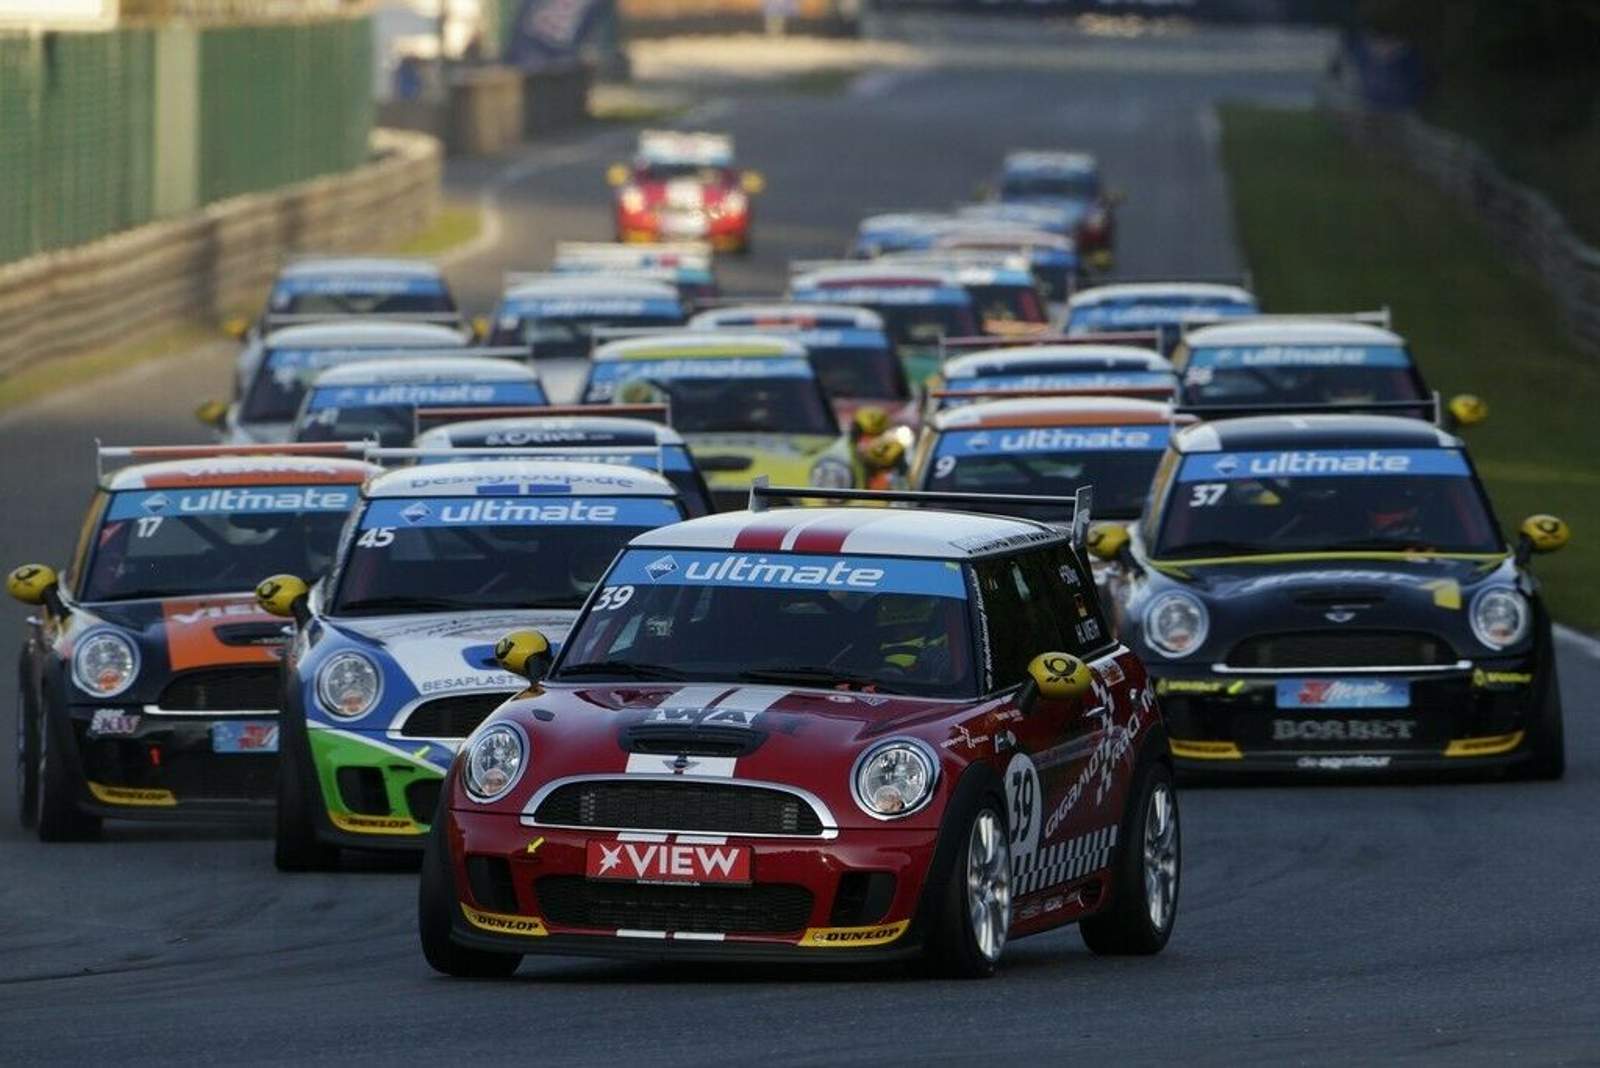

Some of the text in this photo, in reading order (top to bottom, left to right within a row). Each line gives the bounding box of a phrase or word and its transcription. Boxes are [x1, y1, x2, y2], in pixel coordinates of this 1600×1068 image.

[1000, 428, 1151, 450] ultimate
[934, 456, 956, 478] 9
[1251, 452, 1411, 474] ultimate
[180, 488, 349, 511] ultimate
[1189, 484, 1227, 507] 37
[439, 501, 619, 523] ultimate
[136, 517, 163, 538] 17
[357, 527, 398, 549] 45
[684, 555, 884, 588] ultimate
[591, 585, 635, 612] 39
[422, 675, 516, 692] BESAPLAST
[1273, 719, 1416, 740] BORBET
[1009, 767, 1035, 845] 39
[348, 817, 412, 829] DUNLOP
[625, 844, 740, 878] VIEW
[476, 915, 540, 932] DUNLOP
[824, 927, 900, 943] DUNLOP
